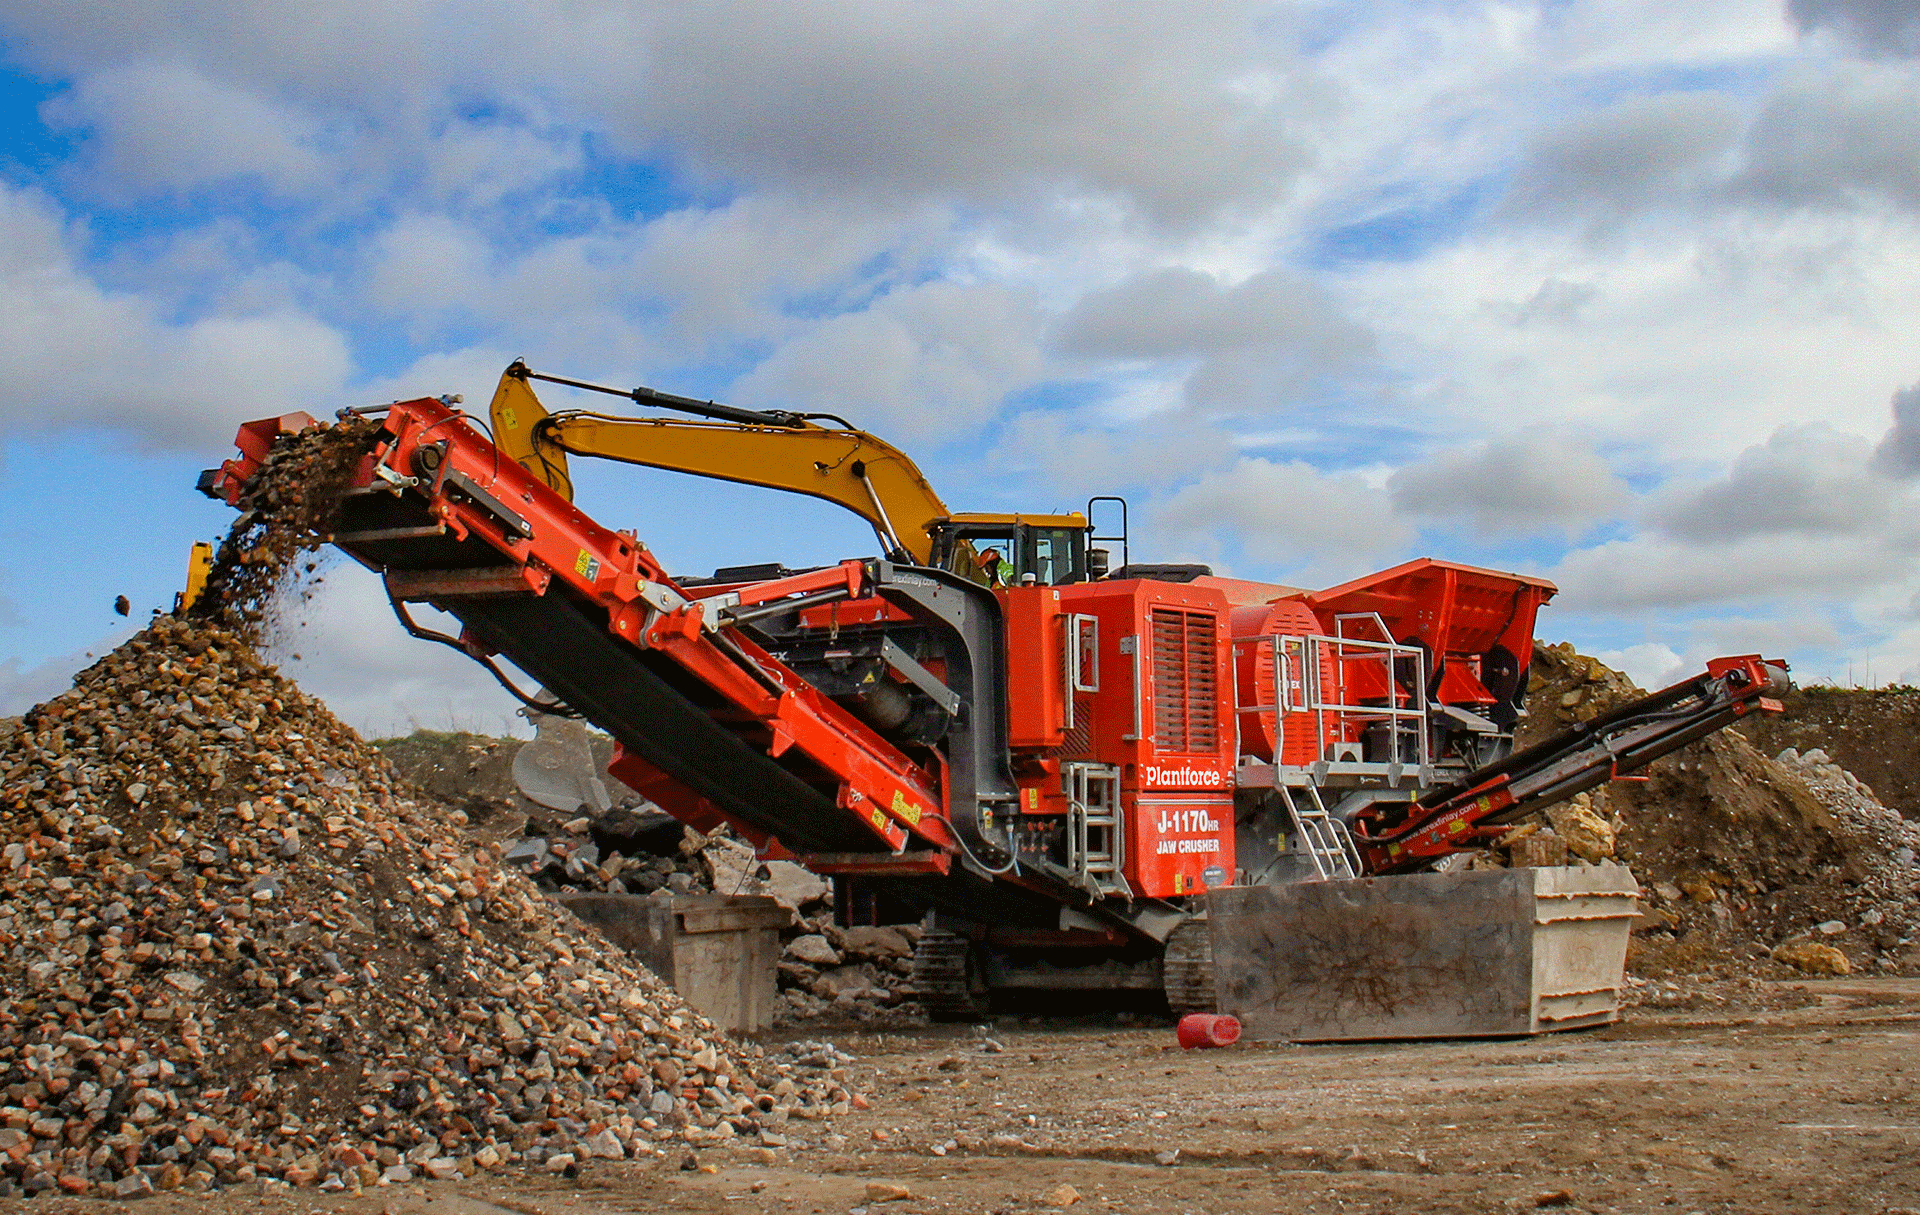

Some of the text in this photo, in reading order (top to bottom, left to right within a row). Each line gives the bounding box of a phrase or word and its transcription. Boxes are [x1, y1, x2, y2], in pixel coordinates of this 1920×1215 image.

[1146, 766, 1220, 786] Plantforce
[1400, 802, 1477, 844] www.terexfinlay.com
[1156, 838, 1220, 855] JAW CRUSHER
